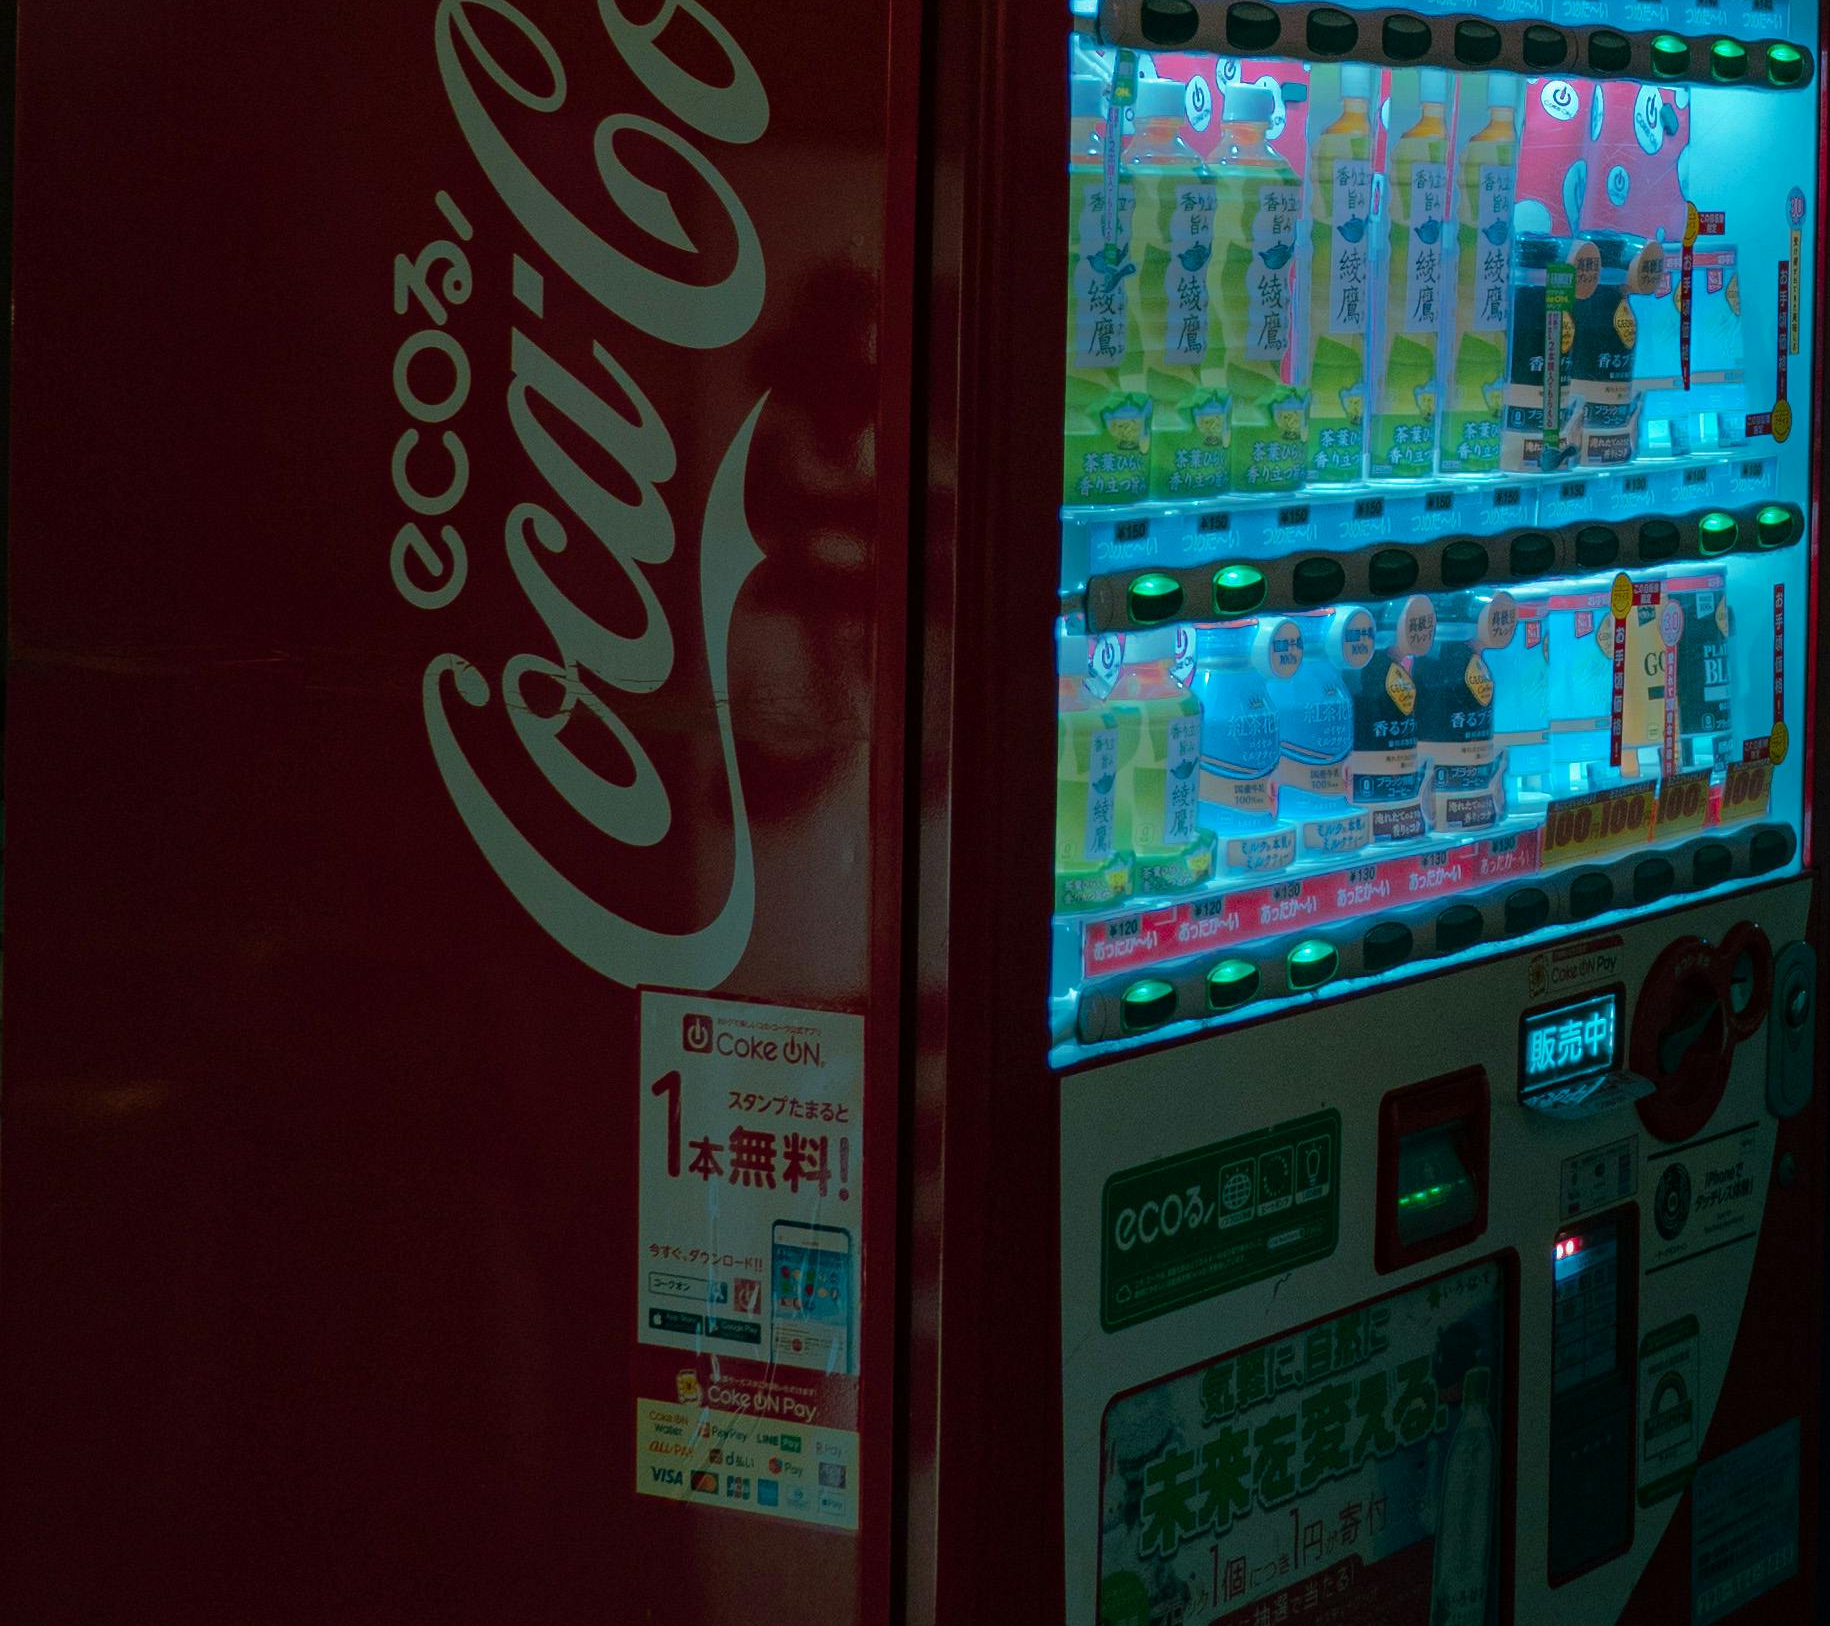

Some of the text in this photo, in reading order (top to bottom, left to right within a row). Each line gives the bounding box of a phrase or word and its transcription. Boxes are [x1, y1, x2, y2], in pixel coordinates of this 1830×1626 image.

[1337, 249, 1363, 324] 綾鷹
[1413, 249, 1438, 323] 綾鷹
[1481, 252, 1504, 326] 綾鷹
[1177, 275, 1203, 354] 綾鷹
[1258, 272, 1283, 351] 綾鷹
[1194, 901, 1222, 916] ¥120
[1108, 921, 1138, 936] ¥120
[1552, 965, 1577, 984] Coke
[1597, 956, 1616, 973] Pay
[717, 1032, 820, 1067] Coke ON
[1528, 1010, 1607, 1074] 販売中
[729, 1092, 849, 1123] スタンプたまると
[652, 1070, 849, 1202] 1本無料!
[649, 1243, 763, 1272] 今すぐ、ダウンロード!!
[708, 1385, 750, 1408] Coke
[753, 1389, 780, 1413] ON
[783, 1397, 817, 1423] Pay
[712, 1422, 747, 1442] PayPay
[757, 1434, 779, 1446] LINE
[651, 1466, 683, 1485] VISA
